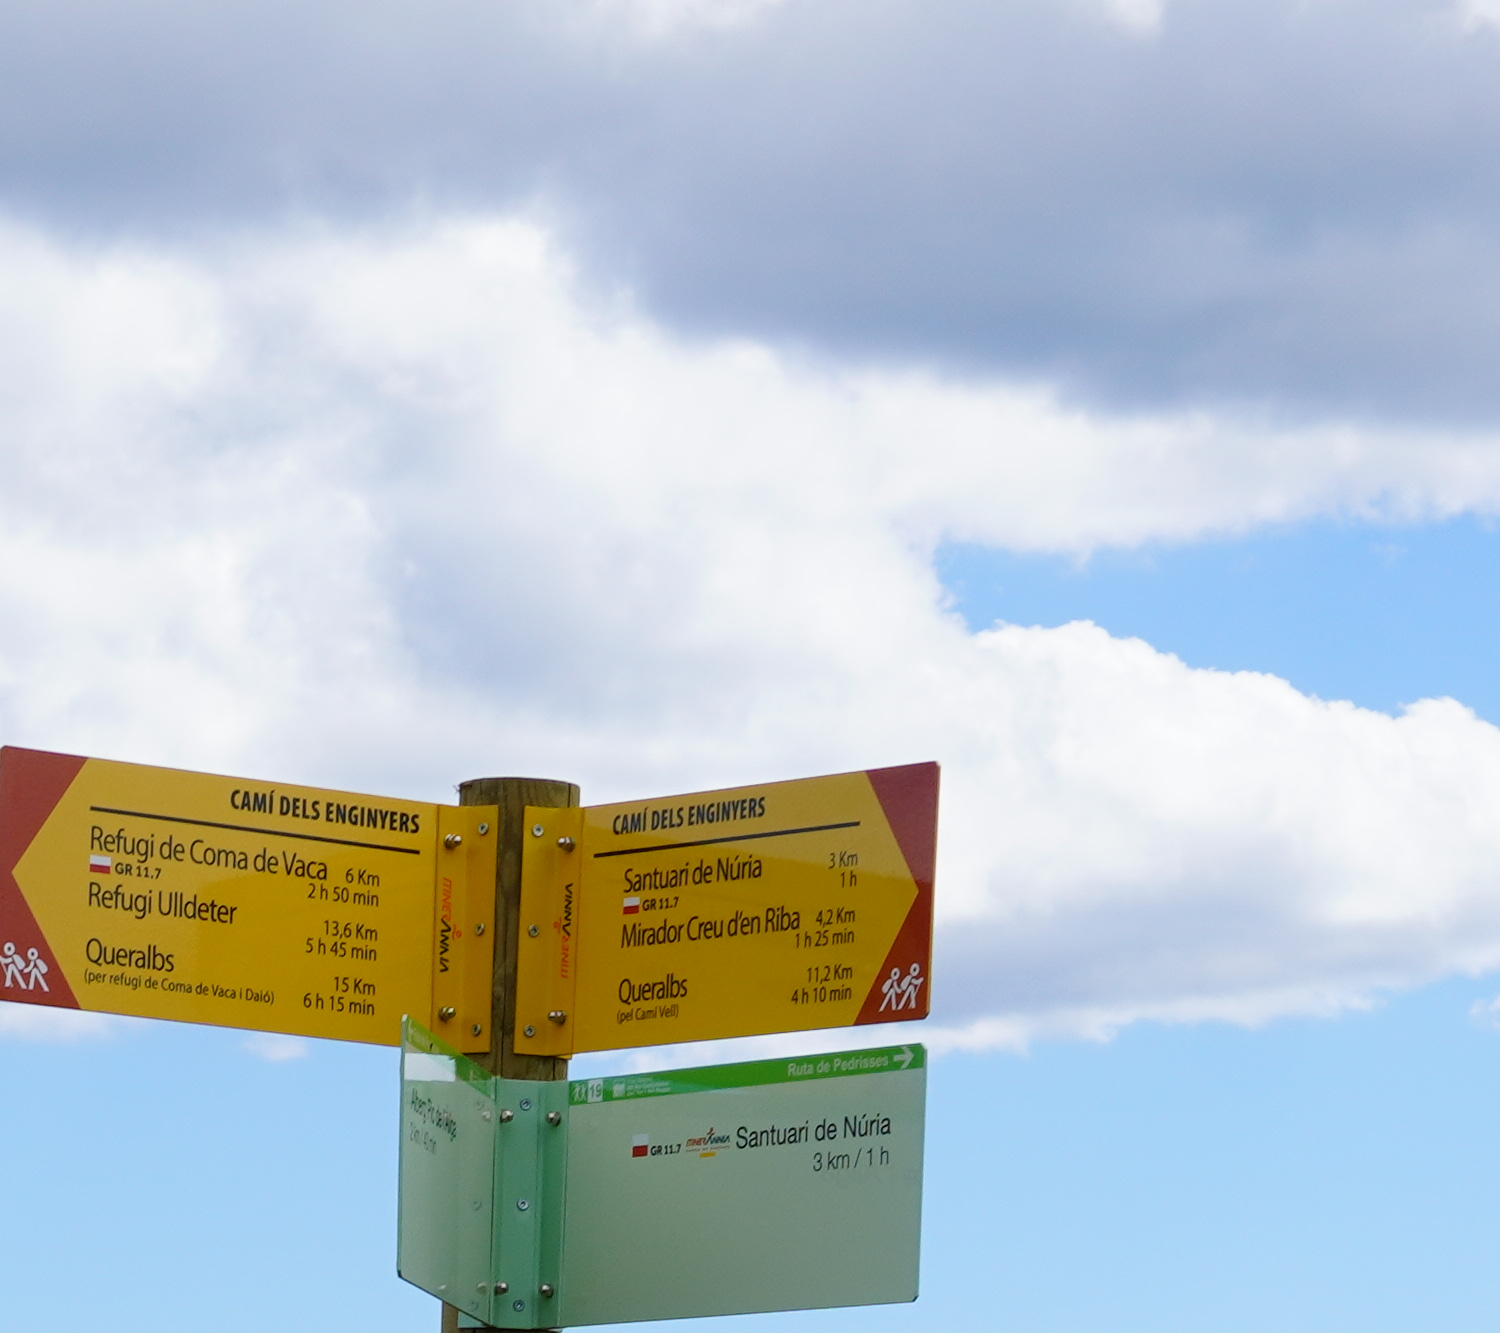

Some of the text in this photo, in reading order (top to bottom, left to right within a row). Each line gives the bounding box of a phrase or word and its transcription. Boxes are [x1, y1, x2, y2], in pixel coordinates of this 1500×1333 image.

[230, 790, 420, 834] CAMÍ DELS ENGINYERS
[613, 797, 765, 835] CAMÍ DELS ENGINYERS
[90, 826, 327, 880] Refugi de Coma de Vaca
[828, 850, 858, 869] 3 Km
[115, 862, 161, 879] GR 11.7
[346, 868, 380, 887] 6 Km
[624, 854, 762, 893] Santuari de Núria
[840, 870, 857, 888] 1 h
[89, 882, 237, 924] Refugi Ulldeter
[308, 883, 379, 907] 2 h 50 min
[642, 897, 679, 911] GR 11.7
[621, 906, 800, 949] Mirador Creu d'en Riba
[816, 907, 856, 928] 4,2 Km
[324, 920, 378, 941] 13,6 Km
[795, 928, 855, 949] 1 h 25 min
[86, 938, 174, 972] Queralbs
[306, 938, 377, 961] 5 h 45 min
[84, 968, 107, 984] (per
[110, 972, 141, 990] refugi
[145, 976, 158, 990] de
[162, 978, 192, 994] Coma
[195, 982, 209, 996] de
[212, 985, 236, 999] Vaca
[806, 963, 853, 984] 11,2 Km
[334, 977, 376, 996] 15 Km
[618, 973, 688, 1005] Queralbs
[791, 984, 852, 1005] 4 h 10 min
[303, 993, 375, 1016] 6 h 15 min
[788, 1055, 889, 1077] Ruta de Pedrisses
[589, 1083, 602, 1099] 19
[650, 1145, 662, 1156] GR
[664, 1143, 682, 1155] 11.7
[736, 1120, 809, 1149] Santuari
[814, 1118, 837, 1141] de
[843, 1113, 891, 1139] Núria
[813, 1146, 889, 1171] 3 km / 1 h
